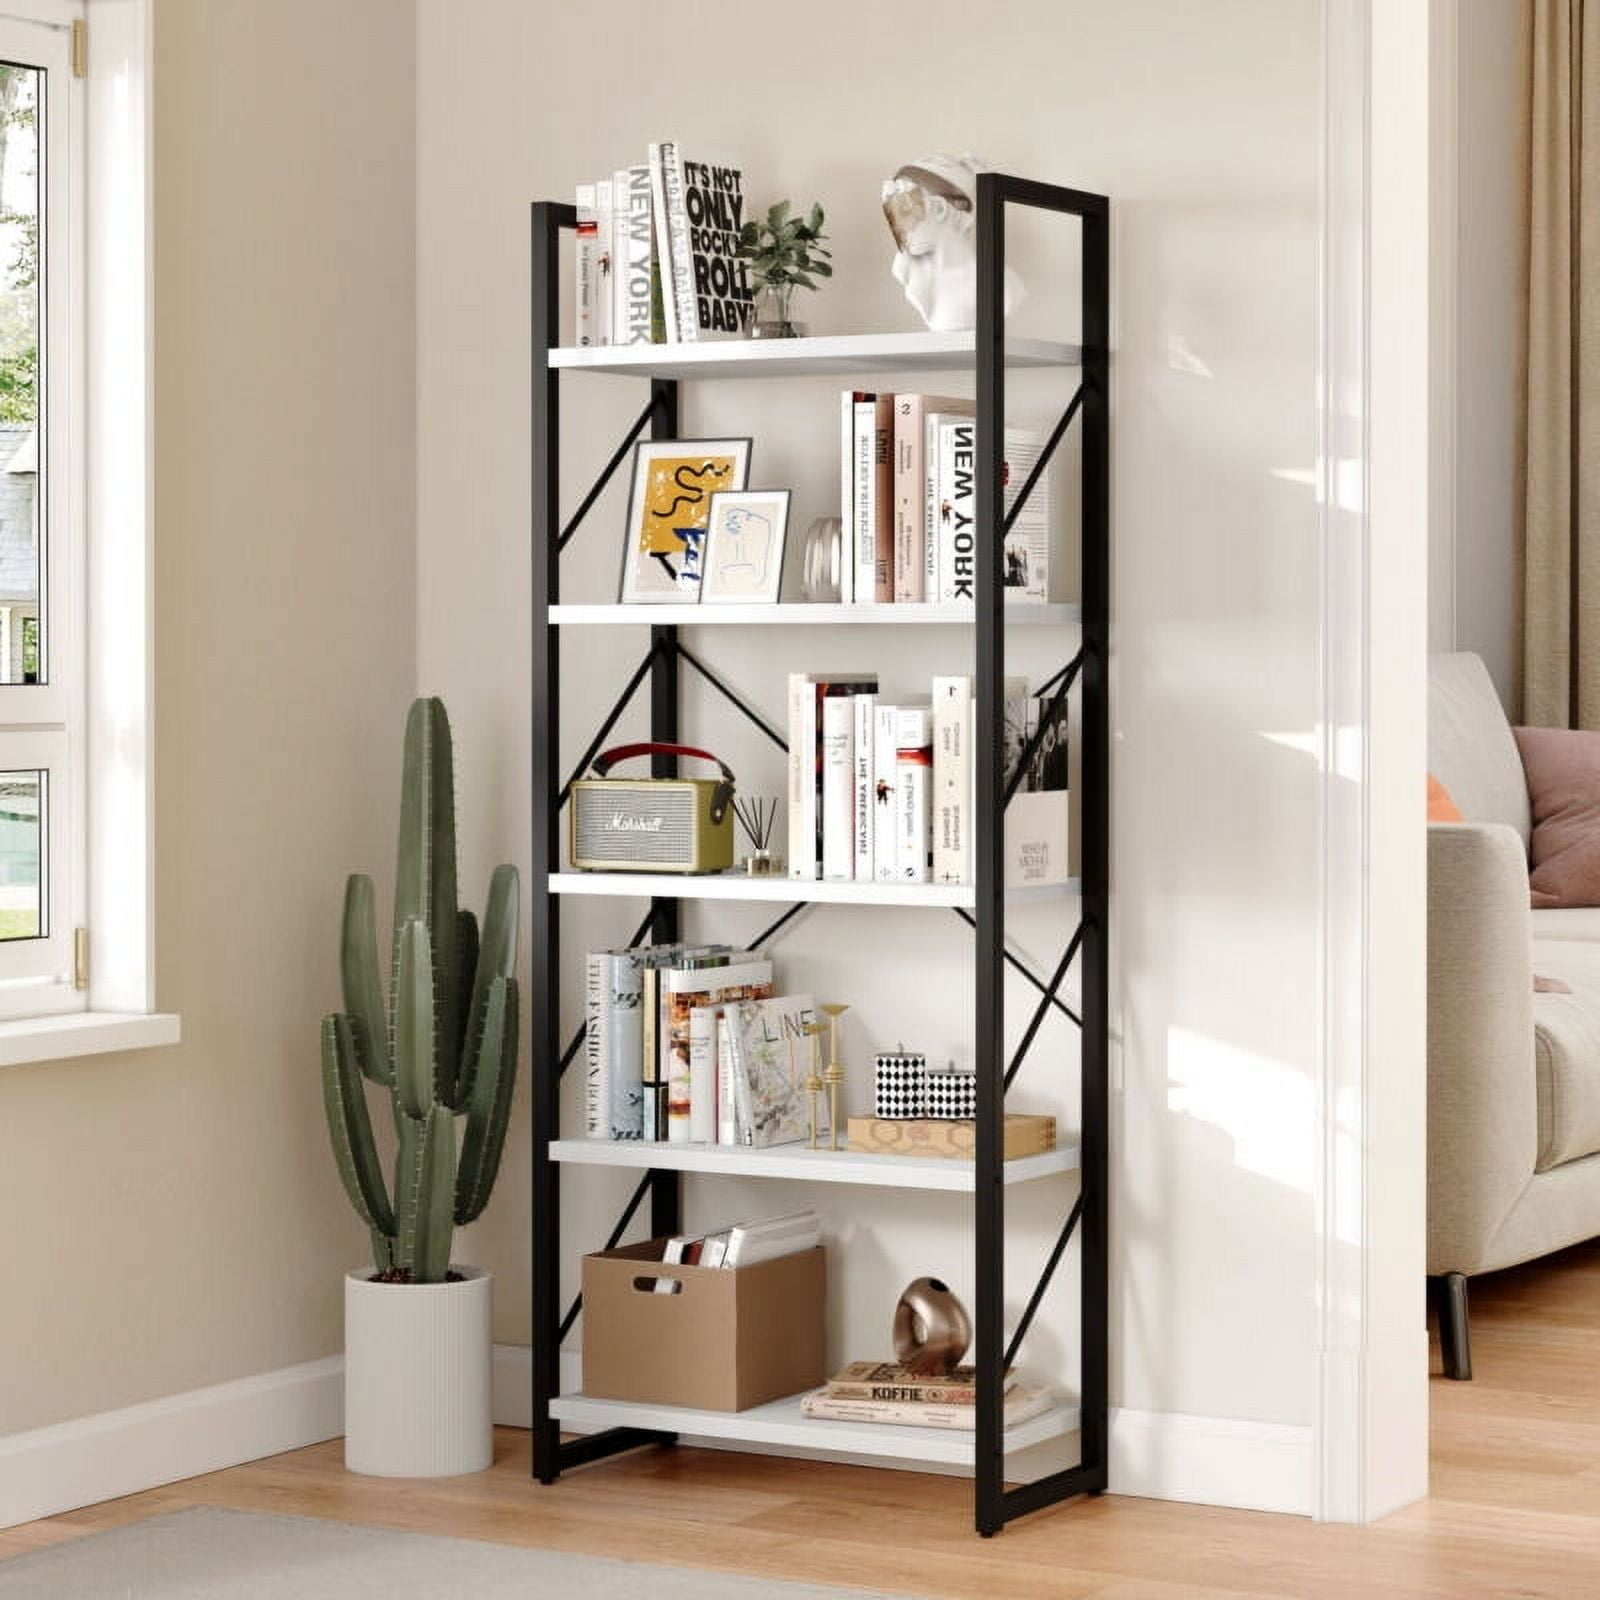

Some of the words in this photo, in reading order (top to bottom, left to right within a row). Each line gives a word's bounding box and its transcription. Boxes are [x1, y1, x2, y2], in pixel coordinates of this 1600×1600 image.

[684, 160, 710, 189] IT'S
[711, 166, 742, 193] NOT
[629, 169, 650, 243] NEW
[686, 186, 743, 233] ONLY
[693, 253, 753, 302] ROLL
[629, 258, 650, 345] YORK
[761, 1009, 816, 1043] LINE
[871, 1387, 923, 1402] KOFFIE
